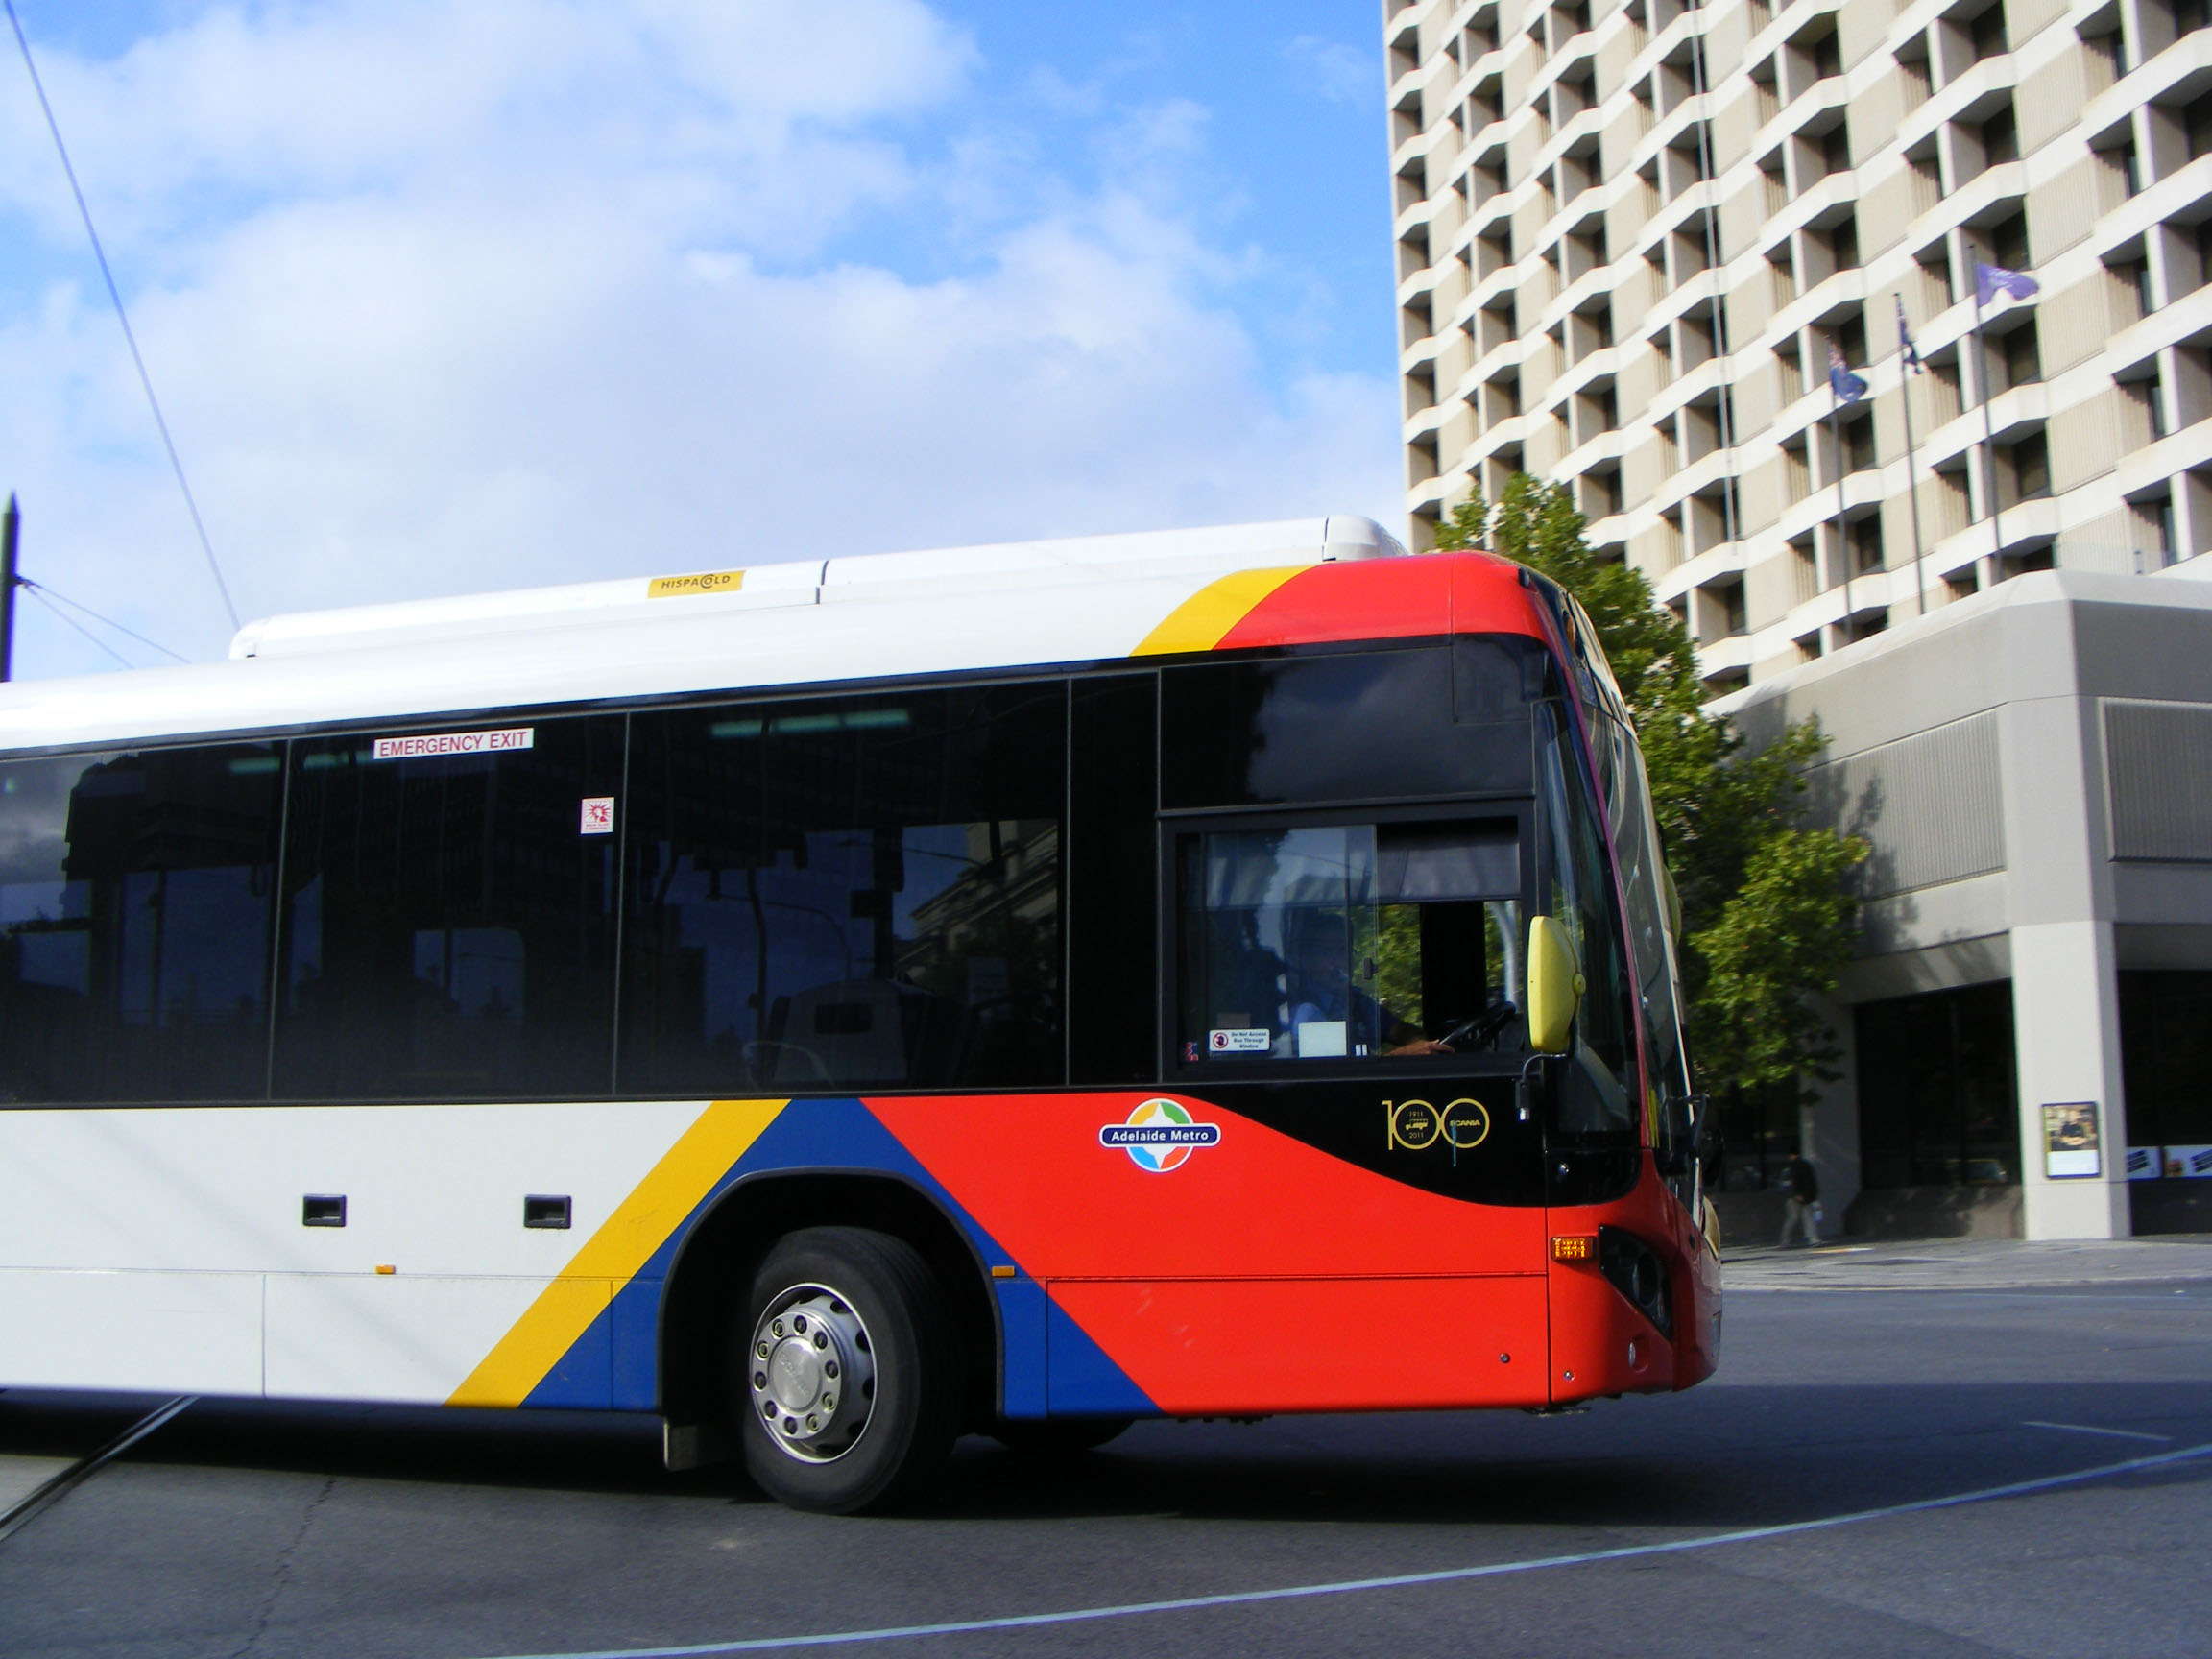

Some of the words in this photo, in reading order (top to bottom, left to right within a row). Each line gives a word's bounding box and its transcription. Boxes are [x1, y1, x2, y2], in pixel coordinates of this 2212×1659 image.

[379, 735, 484, 757] EMERGENCY
[489, 732, 528, 749] EXIT
[1111, 1130, 1166, 1142] Adelaide
[1170, 1130, 1209, 1141] Metro
[1382, 1098, 1490, 1150] 100
